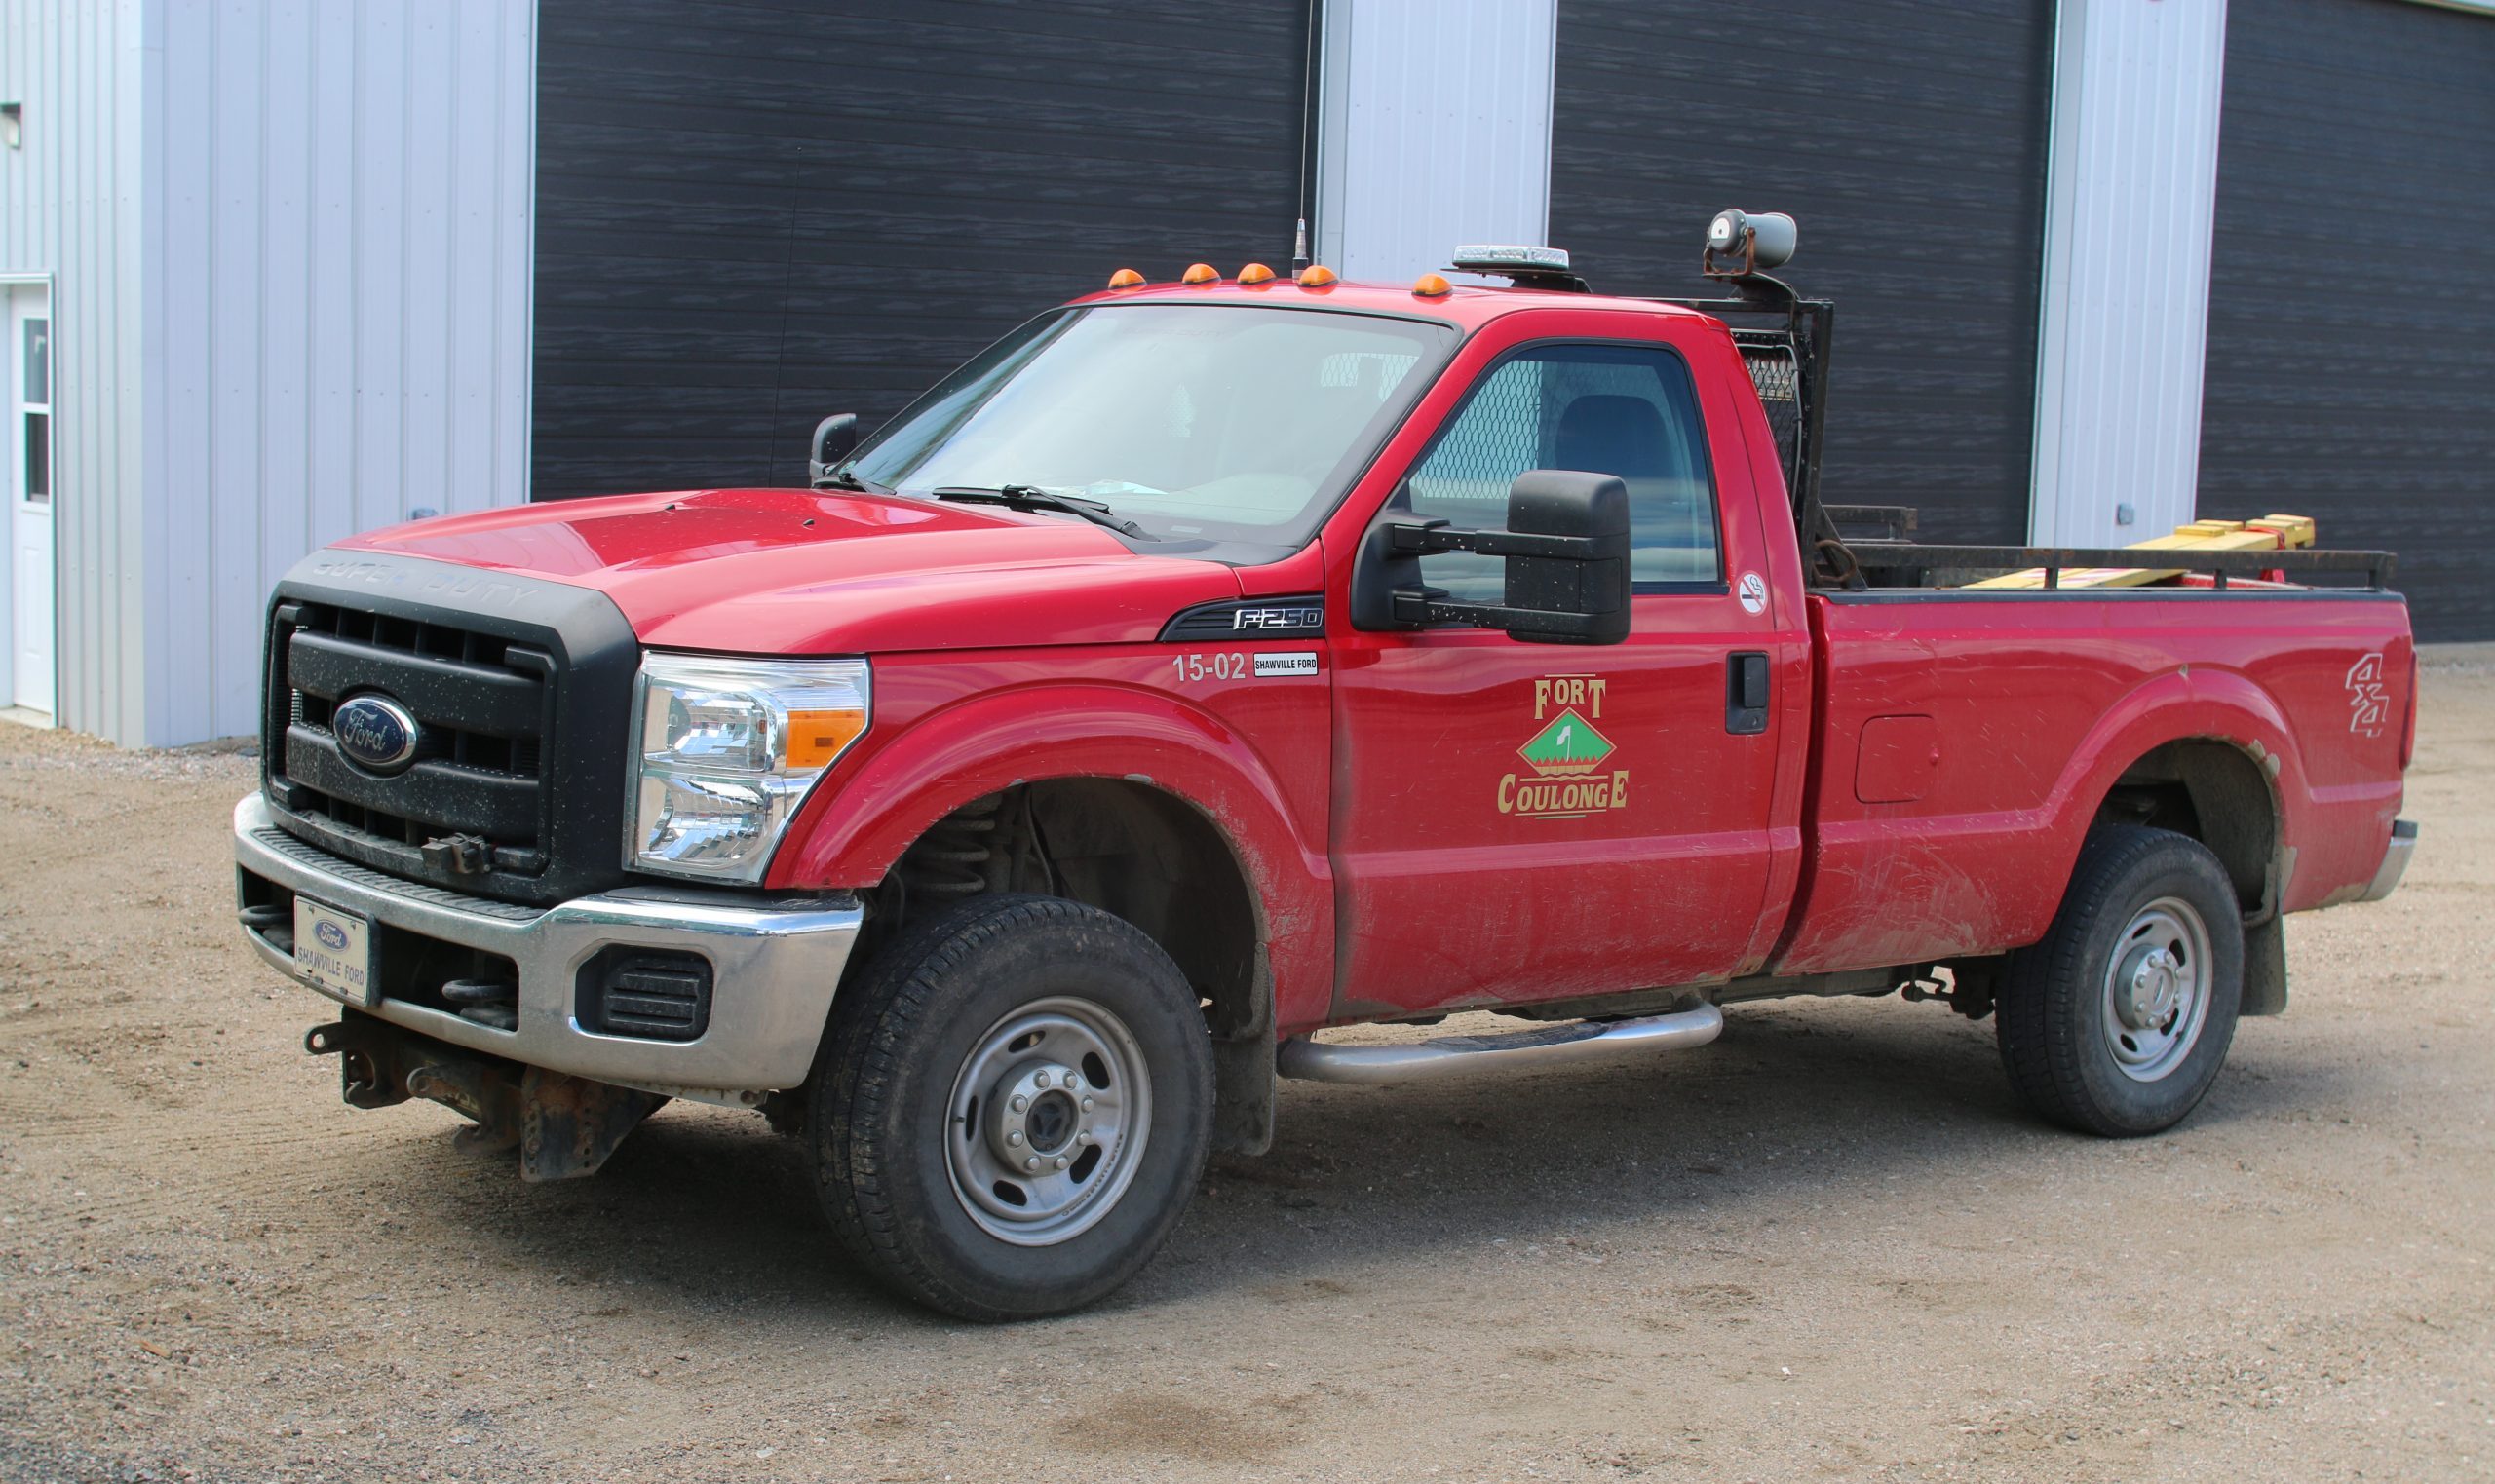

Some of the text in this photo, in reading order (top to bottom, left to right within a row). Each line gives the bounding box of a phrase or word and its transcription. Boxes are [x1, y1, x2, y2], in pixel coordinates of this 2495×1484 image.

[313, 562, 539, 607] SUPER DUTY
[1233, 608, 1324, 629] F-250
[1172, 652, 1246, 681] 15-02
[1255, 658, 1317, 670] SHAWVILLE FORD
[1534, 679, 1606, 720] FORT
[344, 708, 388, 751] Ford
[1497, 770, 1630, 814] COULONGE
[320, 923, 342, 947] Ford
[297, 947, 365, 986] SHAWVILLE FORD
